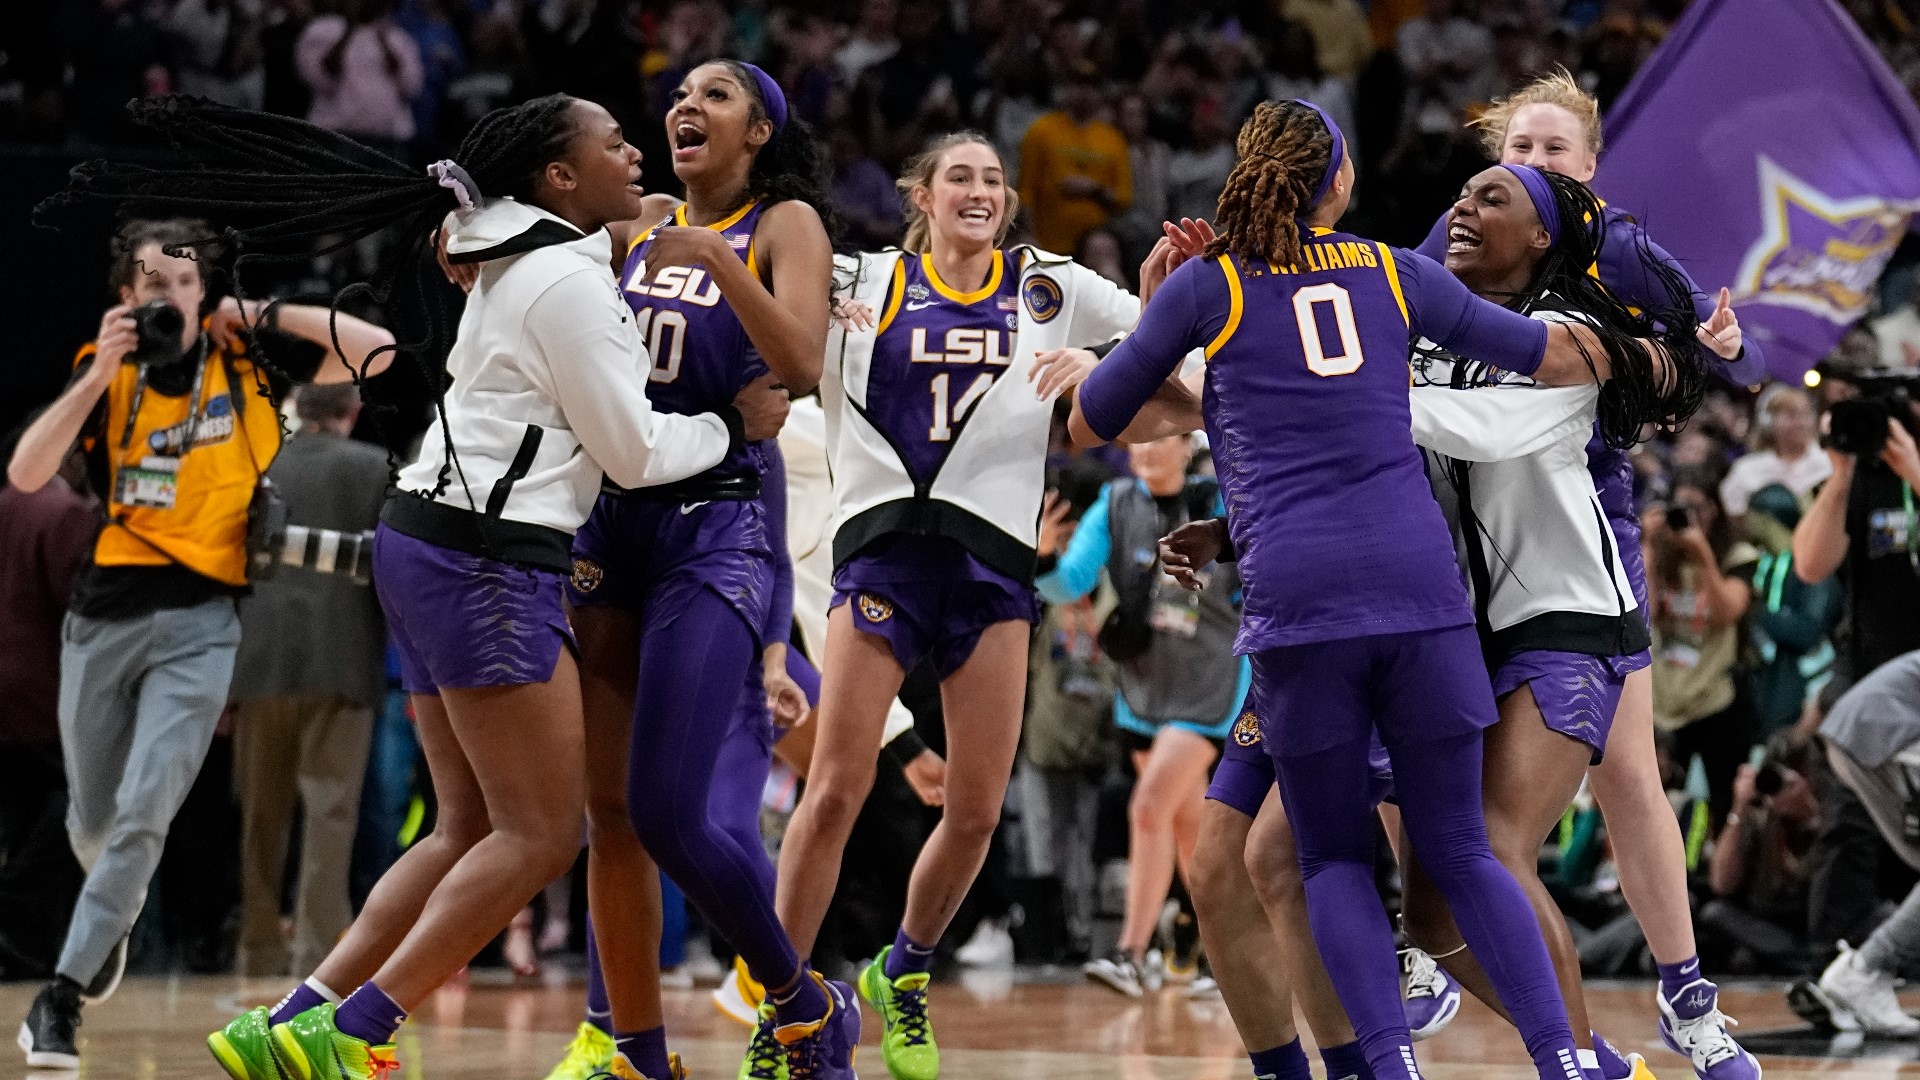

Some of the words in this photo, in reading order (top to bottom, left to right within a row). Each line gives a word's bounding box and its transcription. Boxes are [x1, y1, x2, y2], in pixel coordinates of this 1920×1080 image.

[1267, 241, 1378, 275] LIAMS
[625, 260, 722, 307] LSU
[911, 328, 1018, 365] LSU
[1292, 282, 1364, 377] 0
